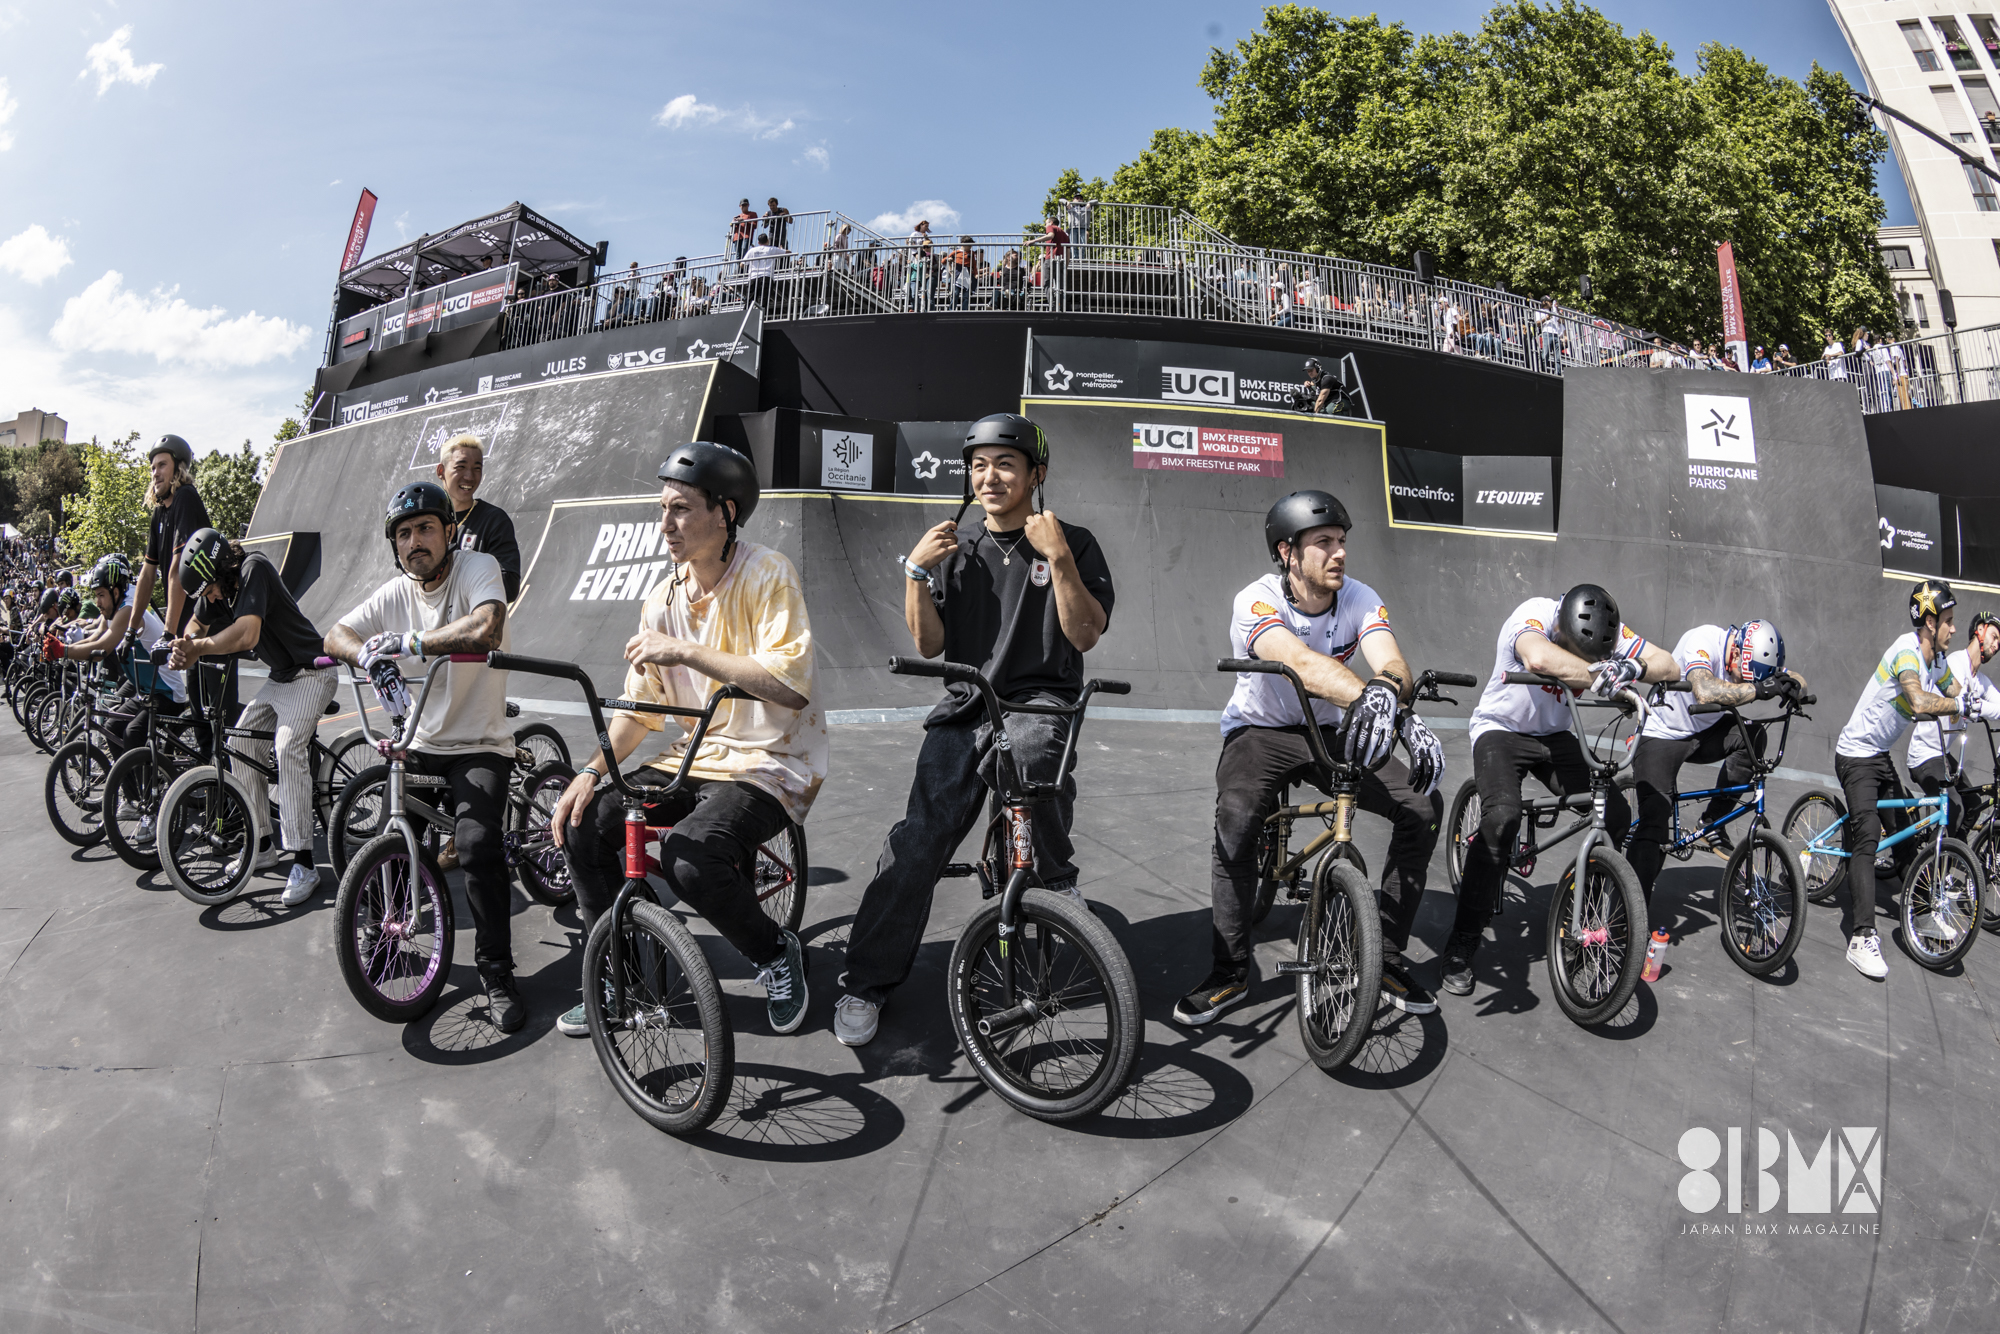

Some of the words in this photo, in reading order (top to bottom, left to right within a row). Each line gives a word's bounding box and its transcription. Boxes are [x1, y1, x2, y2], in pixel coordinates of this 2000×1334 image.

[477, 215, 500, 229] WORLD
[499, 211, 513, 222] CUP
[526, 212, 536, 221] UCI
[536, 217, 547, 228] BMX
[546, 221, 570, 239] FREESTYLE
[569, 236, 584, 250] WORLD
[385, 250, 402, 264] WORLD
[401, 246, 414, 256] CUP
[473, 290, 485, 299] BMX
[473, 296, 492, 305] WORLD
[492, 293, 503, 302] CUP
[447, 295, 471, 312] UCI
[422, 312, 434, 321] CUP
[623, 347, 667, 368] TSG
[541, 356, 587, 377] JULES
[495, 373, 522, 383] HURRICANE
[1174, 373, 1230, 397] UCI
[1240, 379, 1267, 390] BMX
[370, 401, 383, 411] BMX
[383, 395, 409, 408] FREESTYLE
[1240, 390, 1281, 402] WORLD
[345, 406, 368, 424] UCI
[370, 407, 388, 418] WORLD
[388, 405, 399, 415] CUP
[1144, 429, 1193, 450] UCI
[1202, 432, 1227, 443] BMX
[1228, 434, 1278, 446] FREESTYLE
[1202, 443, 1239, 454] WORLD
[1240, 445, 1261, 455] CUP
[1161, 457, 1184, 467] BMX
[1186, 458, 1235, 470] FREESTYLE
[1237, 462, 1261, 472] PARK
[1688, 464, 1759, 481] HURRICANE
[828, 472, 867, 483] Occitanie
[1689, 477, 1727, 490] PARKS
[1476, 489, 1545, 506] L'ÉQUIPE
[209, 541, 221, 560] VANS
[569, 560, 668, 601] EVENT
[1743, 623, 1763, 649] Red
[1742, 650, 1754, 680] Bull
[605, 699, 637, 710] REDBMX
[225, 728, 252, 736] mongoose
[965, 1034, 987, 1067] ODYSSEY
